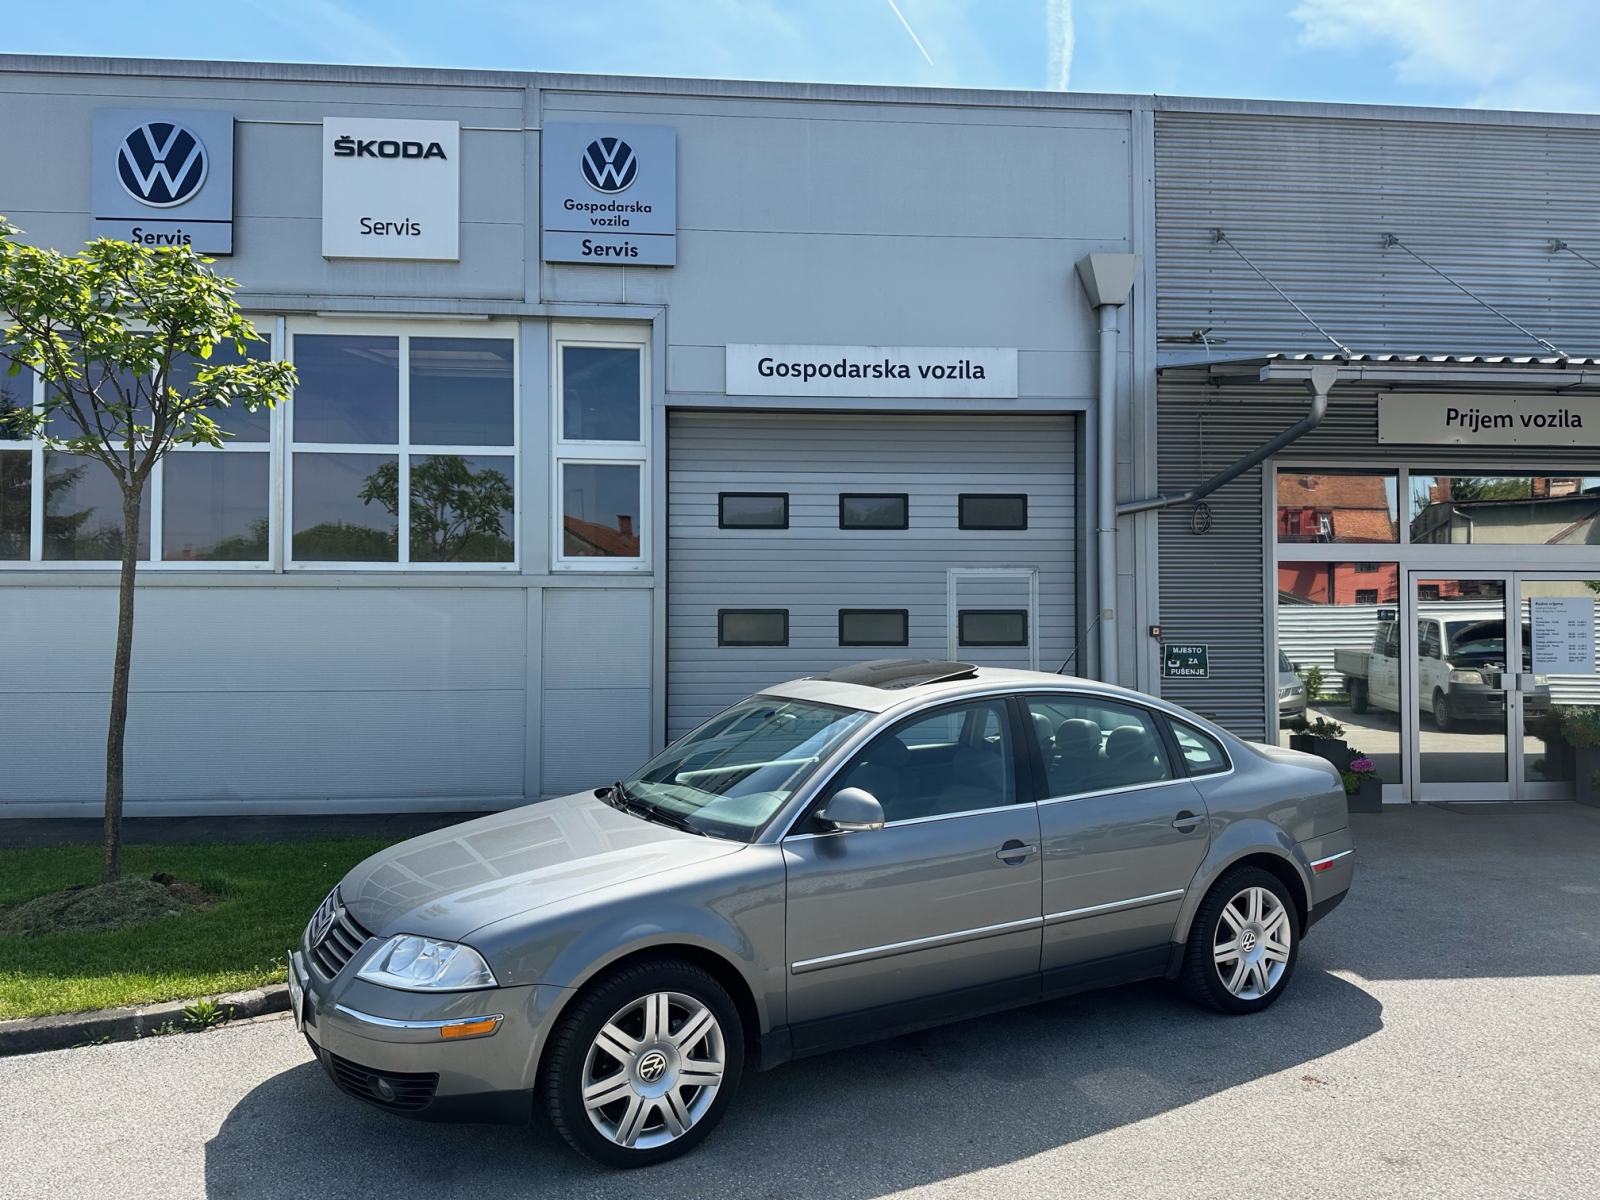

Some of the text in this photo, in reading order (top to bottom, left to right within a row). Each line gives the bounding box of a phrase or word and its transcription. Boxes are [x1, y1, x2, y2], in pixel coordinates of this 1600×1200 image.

[334, 135, 447, 160] ŠKODA
[563, 199, 652, 213] Gospodarska
[360, 217, 421, 236] Servis
[590, 215, 630, 227] vozila
[131, 227, 191, 245] Servis
[581, 239, 639, 257] Servis
[757, 357, 986, 382] Gospodarska vozila
[1446, 408, 1583, 433] Prijem vozila
